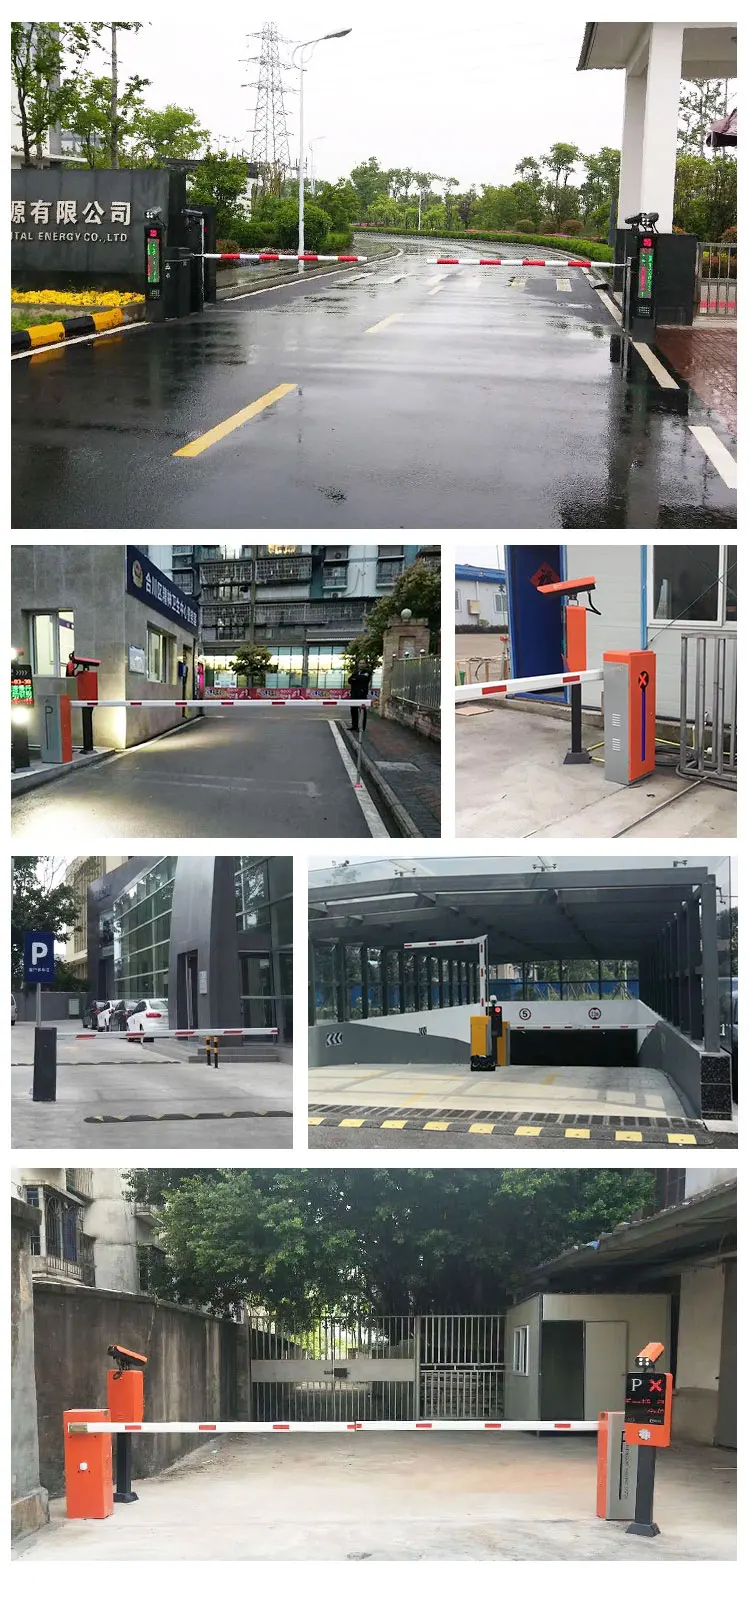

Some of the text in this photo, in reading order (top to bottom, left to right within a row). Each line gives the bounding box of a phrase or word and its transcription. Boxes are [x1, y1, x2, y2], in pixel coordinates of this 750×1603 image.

[11, 199, 131, 226] 源有限公司
[38, 231, 81, 241] ENERGY
[31, 941, 48, 966] P
[631, 1378, 643, 1392] P
